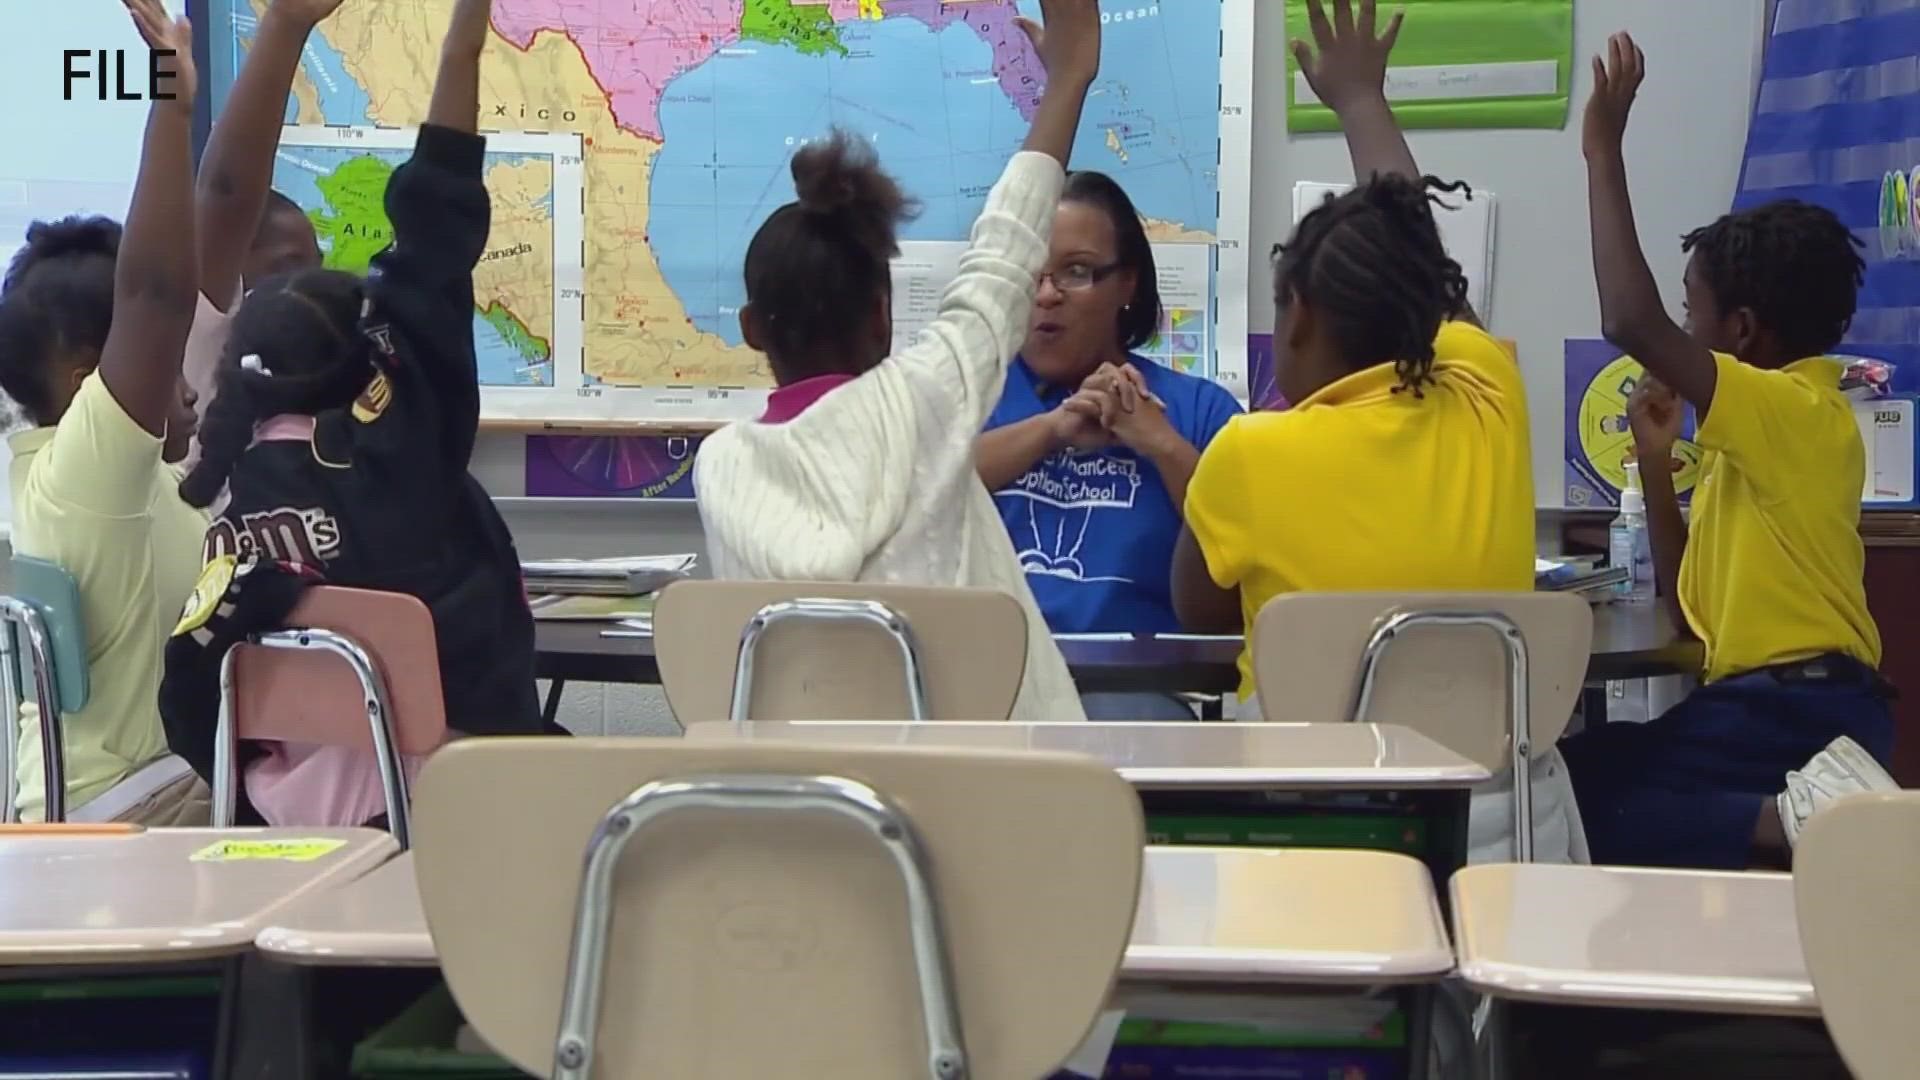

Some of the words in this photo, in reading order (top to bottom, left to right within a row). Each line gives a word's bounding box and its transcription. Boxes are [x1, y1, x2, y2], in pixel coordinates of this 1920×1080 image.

[1101, 5, 1159, 24] Ocean
[940, 3, 1041, 106] Florida
[338, 129, 363, 139] 110°W
[561, 155, 581, 165] 25°N
[561, 290, 581, 299] 20°N
[641, 482, 668, 497] After
[1062, 476, 1116, 501] School
